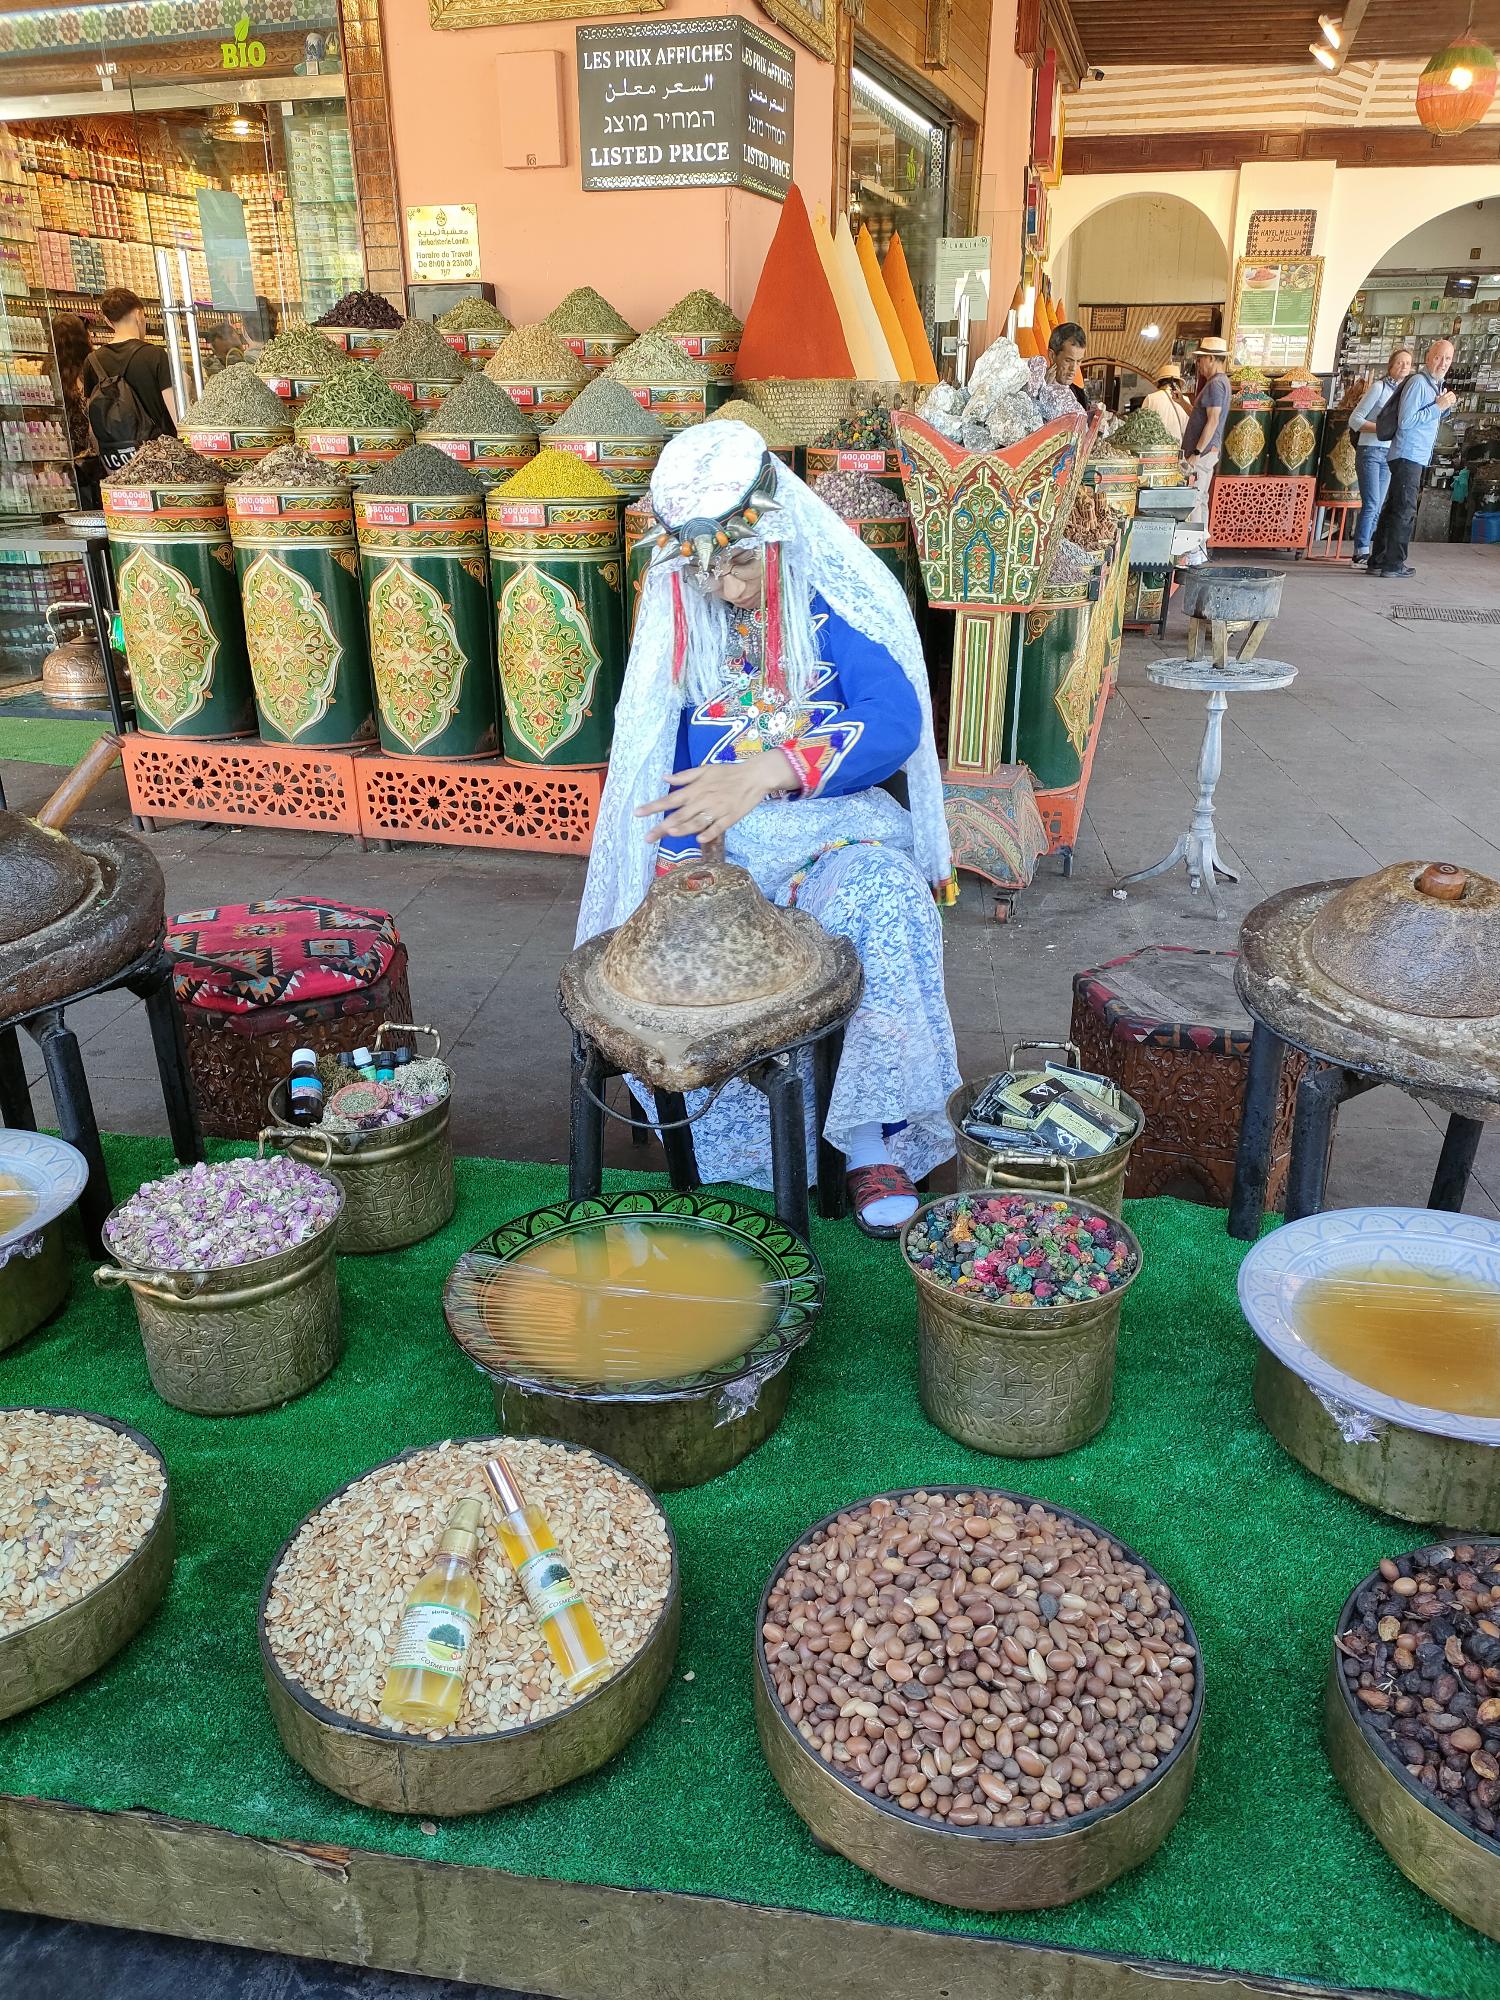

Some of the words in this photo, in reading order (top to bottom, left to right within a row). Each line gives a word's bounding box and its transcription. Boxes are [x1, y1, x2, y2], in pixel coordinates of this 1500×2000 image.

[220, 41, 266, 69] BIO
[584, 51, 611, 70] LES
[615, 48, 652, 68] PRIX
[655, 43, 733, 65] AFFICHES
[741, 46, 753, 68] LES
[752, 54, 767, 76] PRIX
[766, 60, 793, 91] AFFICHES
[605, 78, 656, 102] معلن
[662, 73, 714, 99] السعر
[603, 112, 648, 134] מוצג
[653, 109, 715, 130] המחיר
[590, 145, 663, 167] LISTED
[669, 141, 730, 163] PRICE
[743, 143, 769, 171] LISTED
[769, 155, 791, 180] PRICE
[428, 260, 445, 268] 8h00
[452, 259, 473, 268] 23h00
[841, 453, 882, 463] 400,00dh
[853, 461, 869, 470] 1kg
[379, 513, 394, 523] 1kg
[502, 507, 541, 516] 300,00dh
